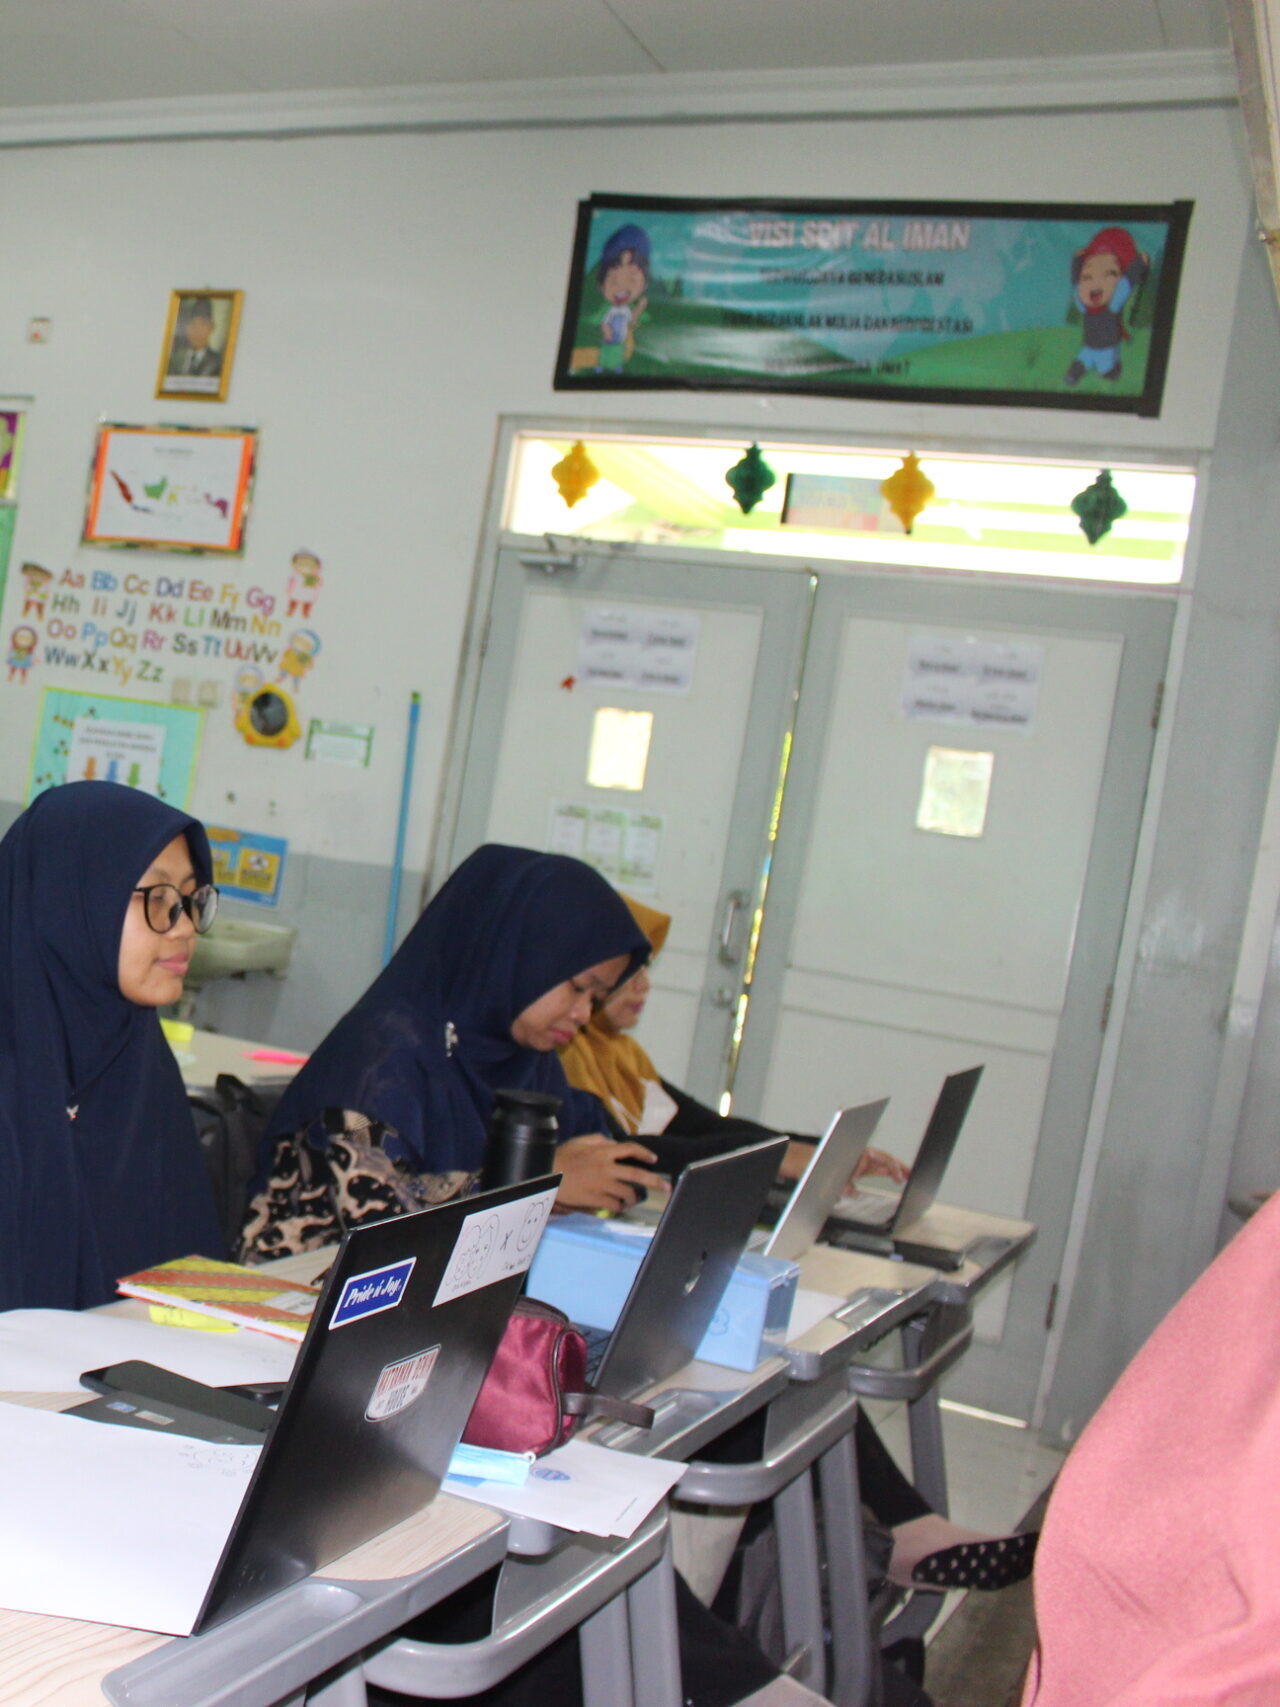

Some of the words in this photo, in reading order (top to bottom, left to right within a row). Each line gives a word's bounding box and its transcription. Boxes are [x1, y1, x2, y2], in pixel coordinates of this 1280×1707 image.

[748, 220, 794, 248] VISI
[864, 223, 895, 251] AL
[903, 221, 971, 252] IMAN
[59, 569, 85, 588] Aa
[91, 570, 117, 592] Bb
[123, 574, 149, 595] Cc
[156, 577, 184, 598] Dd
[188, 580, 213, 602] Ee
[220, 584, 240, 610] Ff
[246, 587, 275, 614] Gg
[52, 594, 80, 614] Hh
[93, 597, 106, 616] Ii
[116, 600, 137, 625] Jj
[148, 604, 177, 624] Kk
[183, 607, 203, 627] Ll
[210, 610, 247, 632] Mm
[250, 615, 281, 636] Nn
[47, 619, 76, 639] Oo
[82, 624, 109, 648] Pp
[109, 627, 137, 650] Qq
[142, 629, 165, 651] Rr
[172, 634, 197, 655] Ss
[202, 635, 223, 657] Tt
[224, 640, 250, 660] Uu
[250, 643, 278, 664] Vv
[44, 646, 81, 667] Ww
[80, 649, 109, 673] Xx
[112, 655, 132, 686] Yy
[136, 659, 164, 682] Zz
[343, 1283, 375, 1308] Pride
